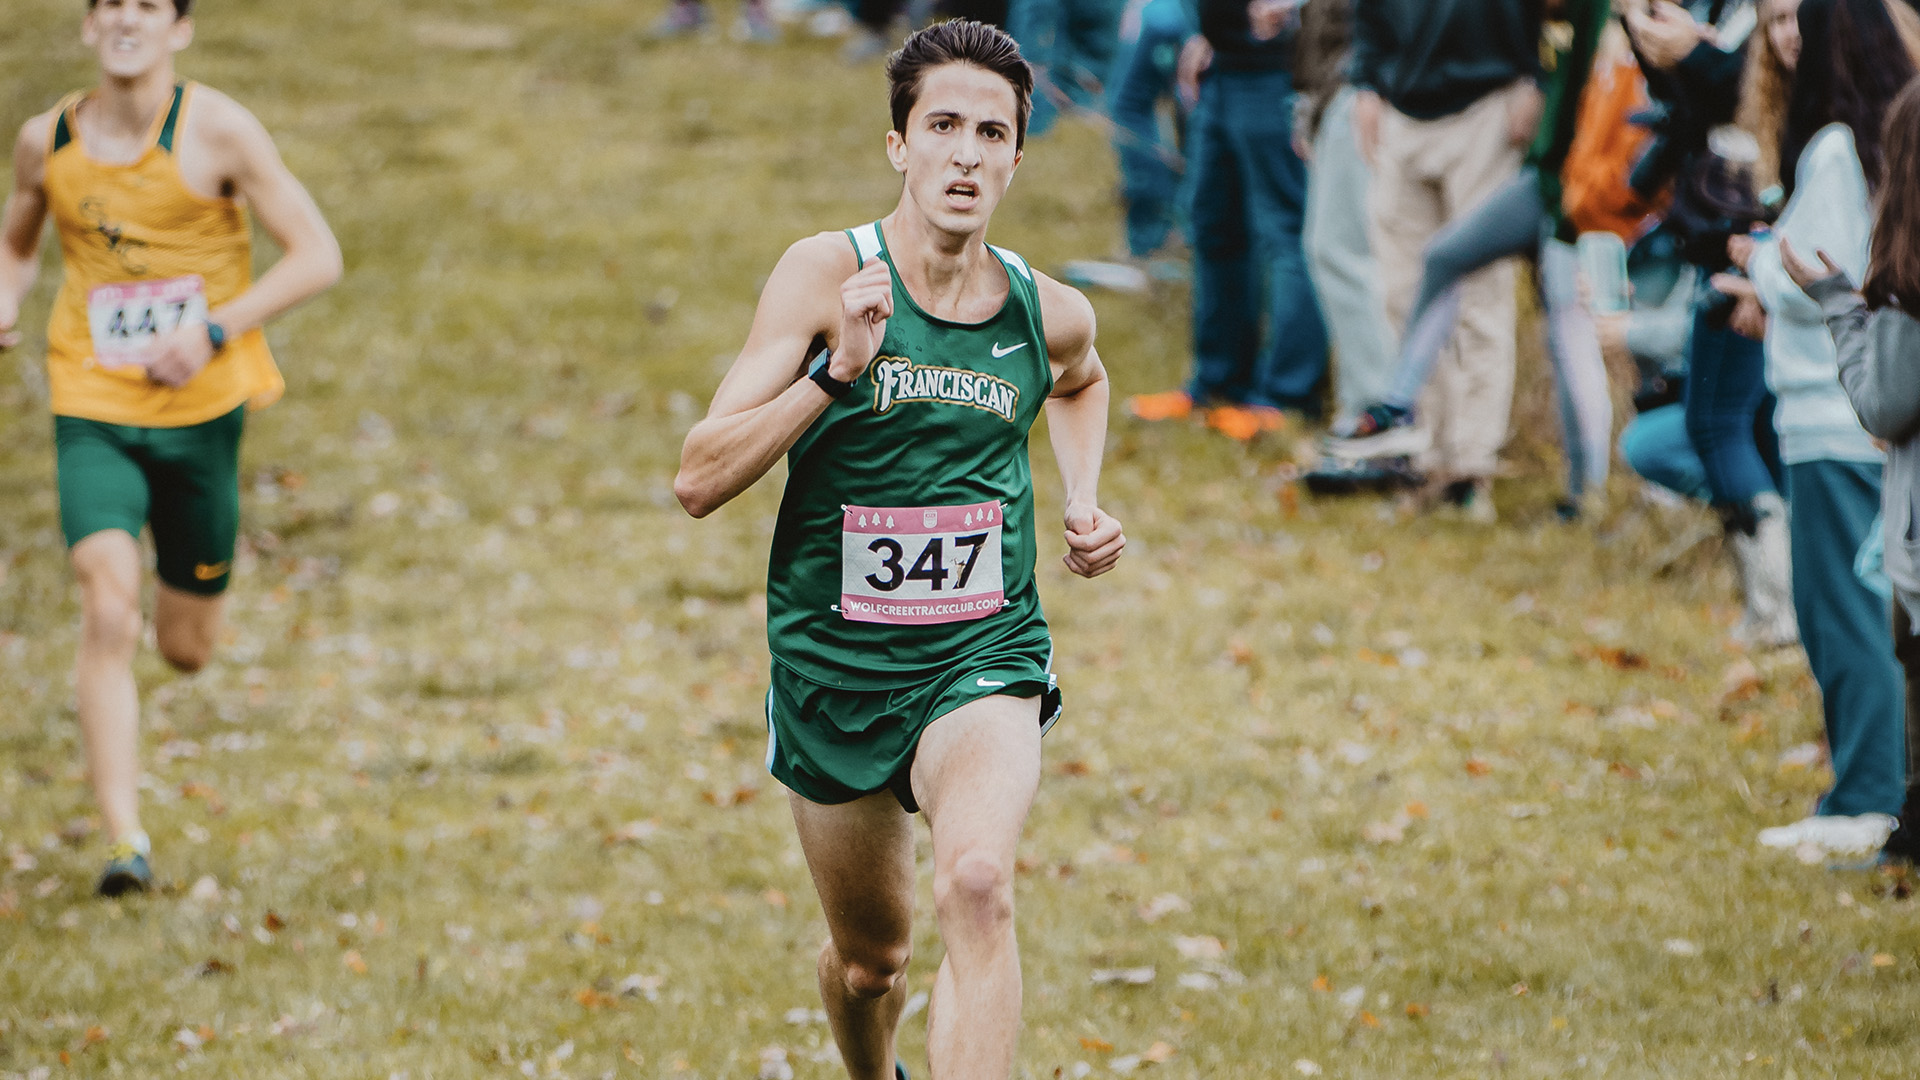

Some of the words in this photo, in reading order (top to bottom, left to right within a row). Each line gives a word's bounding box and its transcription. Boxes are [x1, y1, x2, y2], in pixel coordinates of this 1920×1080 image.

[108, 299, 187, 338] 447
[876, 360, 1016, 419] FRANCISCAN
[865, 532, 989, 592] 347
[850, 598, 999, 616] WOLFCREEKTRACKCLUB.COM
